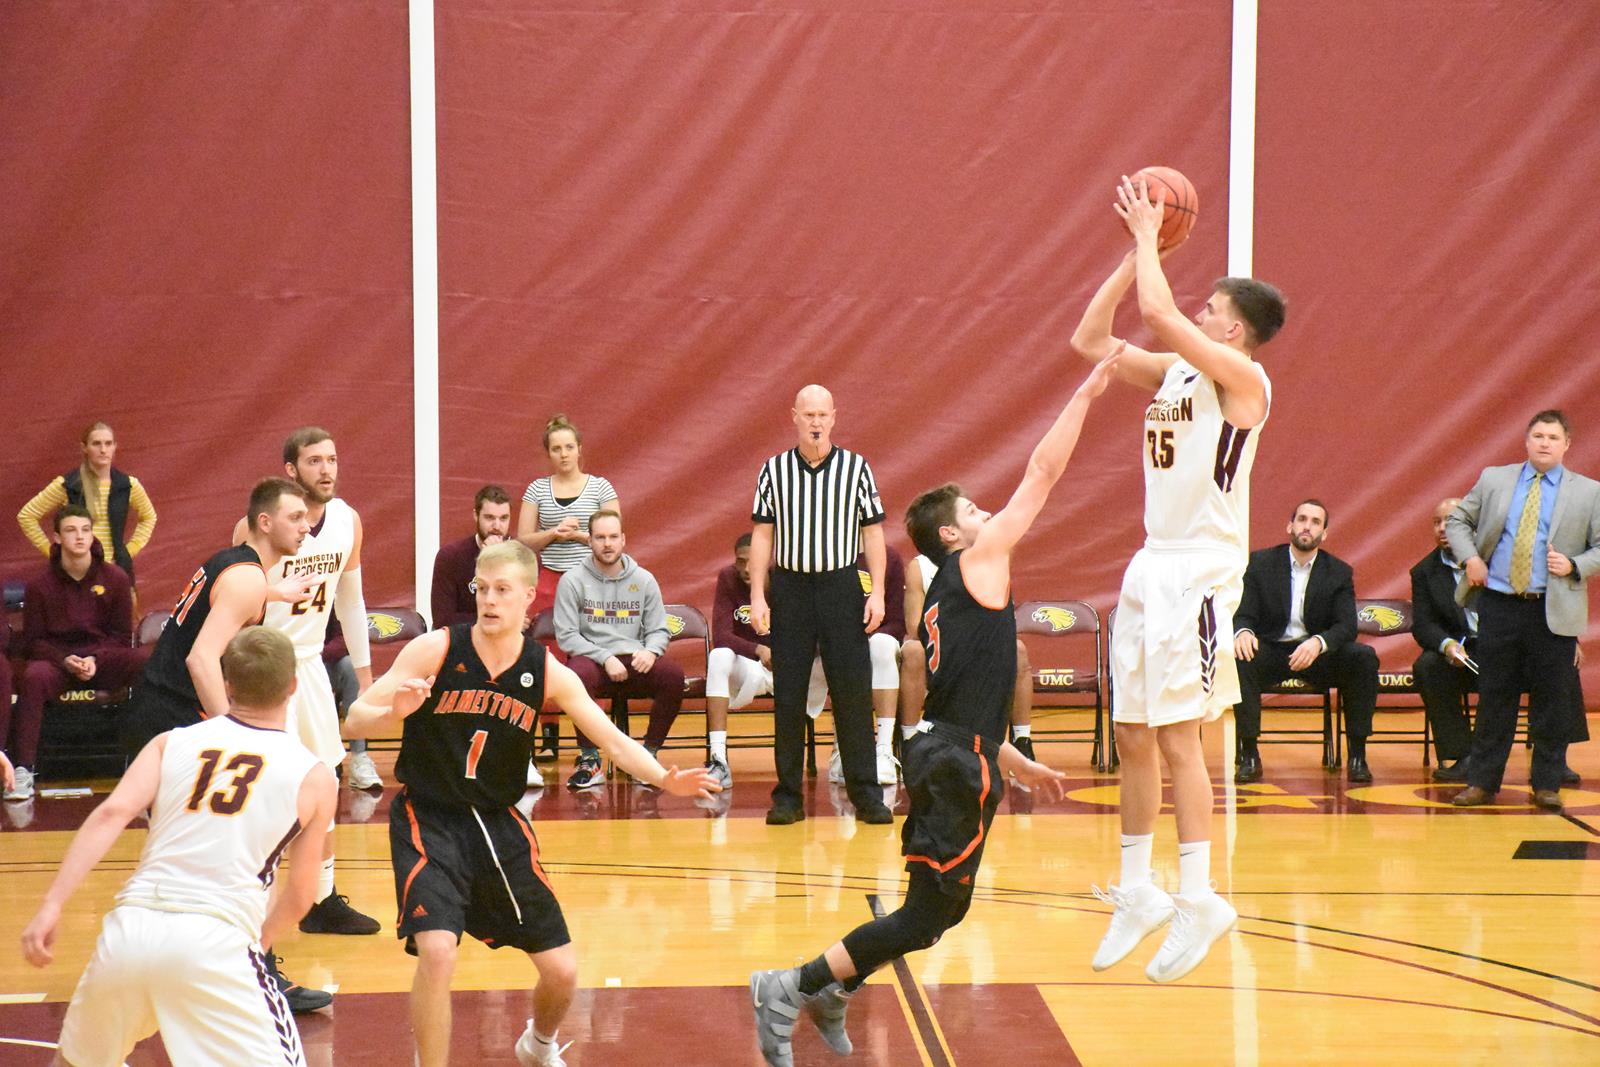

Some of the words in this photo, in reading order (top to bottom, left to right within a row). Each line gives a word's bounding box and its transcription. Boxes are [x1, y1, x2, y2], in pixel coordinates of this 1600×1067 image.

[1147, 429, 1175, 469] 25
[924, 602, 940, 674] 5
[1039, 674, 1074, 686] UMC
[1378, 674, 1414, 687] UMC
[433, 689, 536, 733] JAMESTOWN
[465, 729, 489, 779] 1
[186, 748, 265, 816] 13
